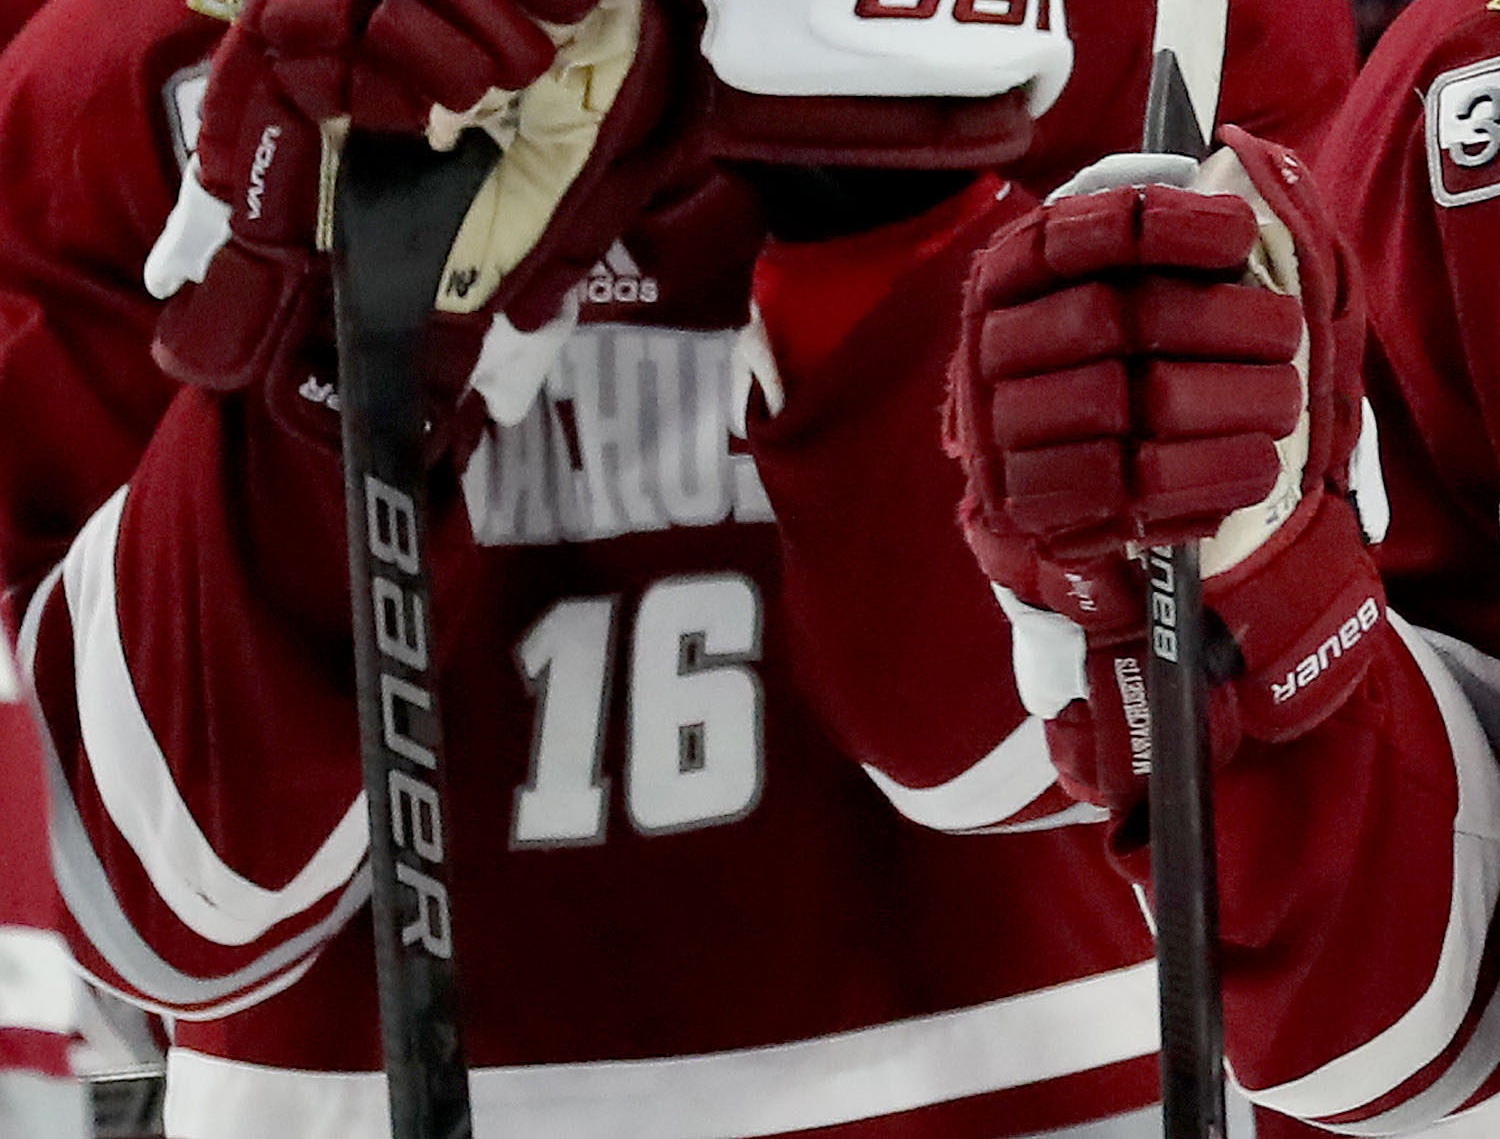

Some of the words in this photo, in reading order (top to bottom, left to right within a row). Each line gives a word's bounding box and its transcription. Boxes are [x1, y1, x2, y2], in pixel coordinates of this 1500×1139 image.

[364, 474, 454, 961] BAUER
[508, 569, 767, 853] 16
[1270, 596, 1380, 704] BAUER
